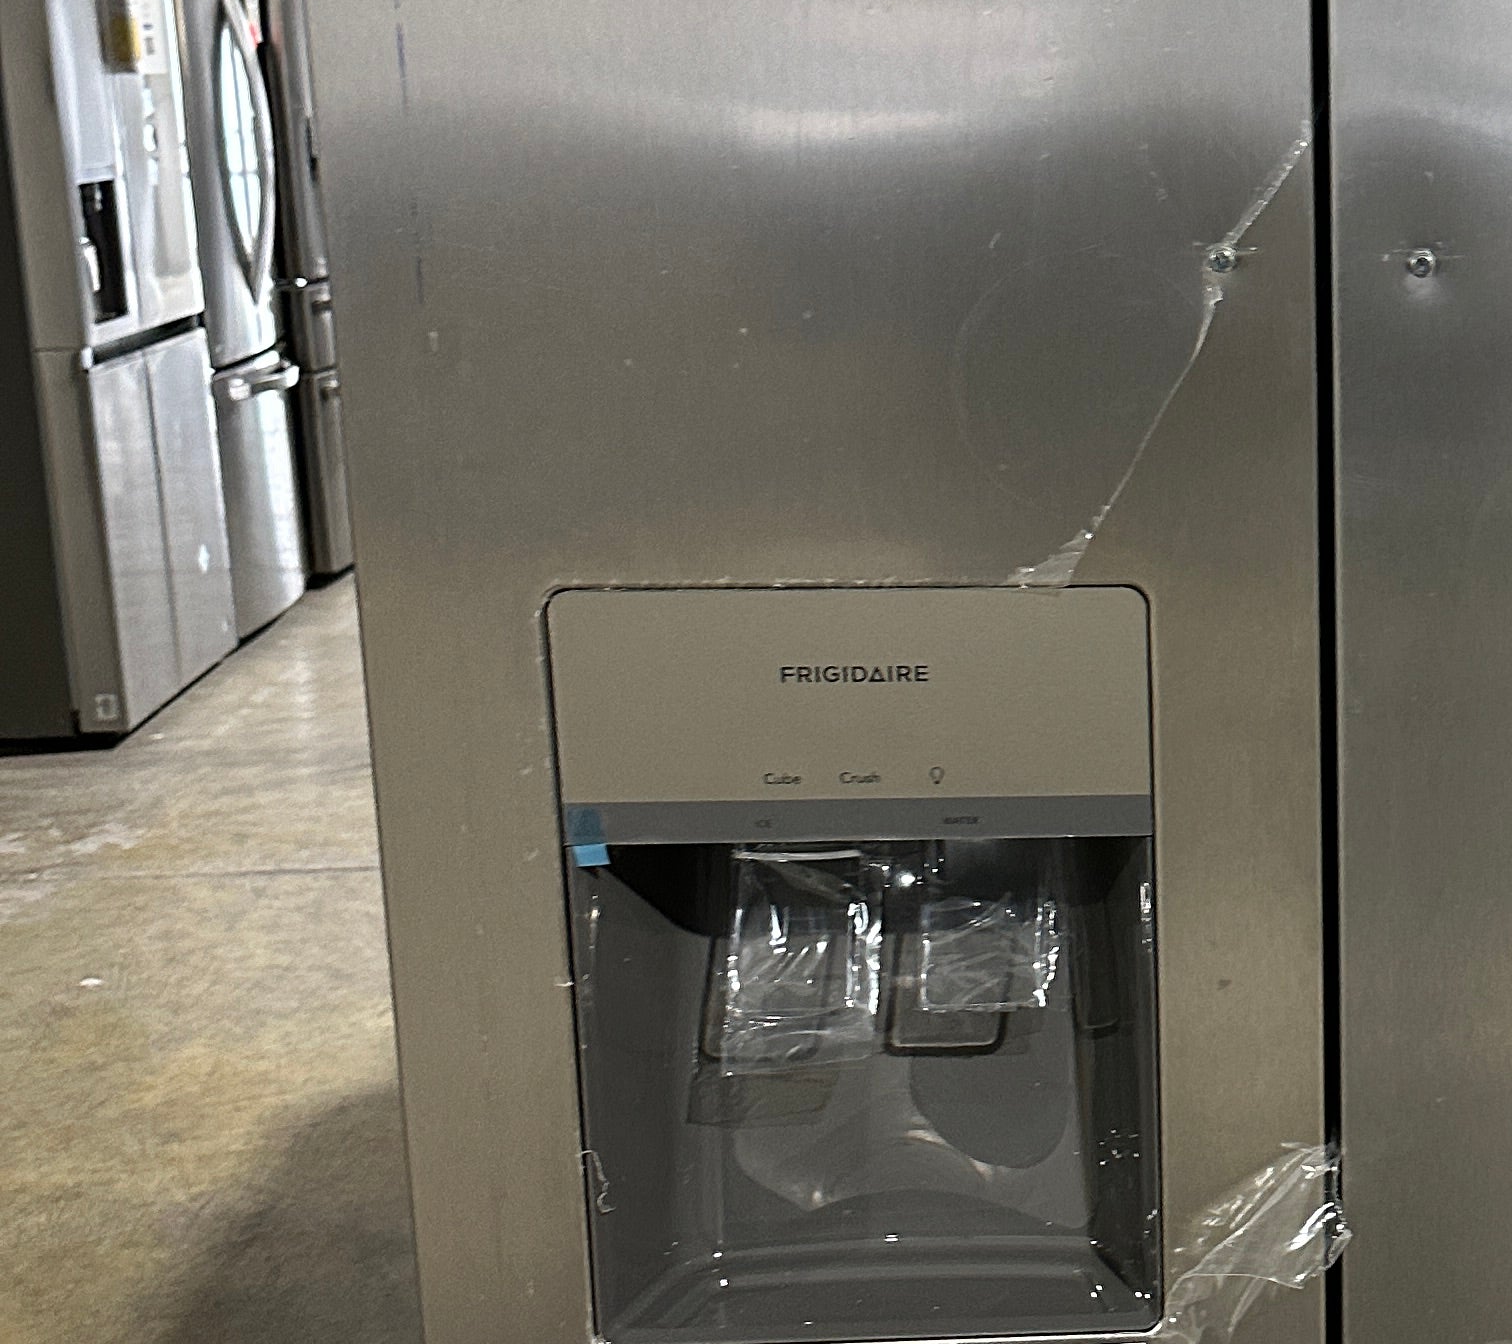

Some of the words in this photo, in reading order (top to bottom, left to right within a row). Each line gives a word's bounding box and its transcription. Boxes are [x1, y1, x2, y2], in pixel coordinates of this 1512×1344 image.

[779, 664, 930, 684] FRIGIDAIRE
[762, 772, 801, 785] Cube
[838, 772, 882, 785] Crush
